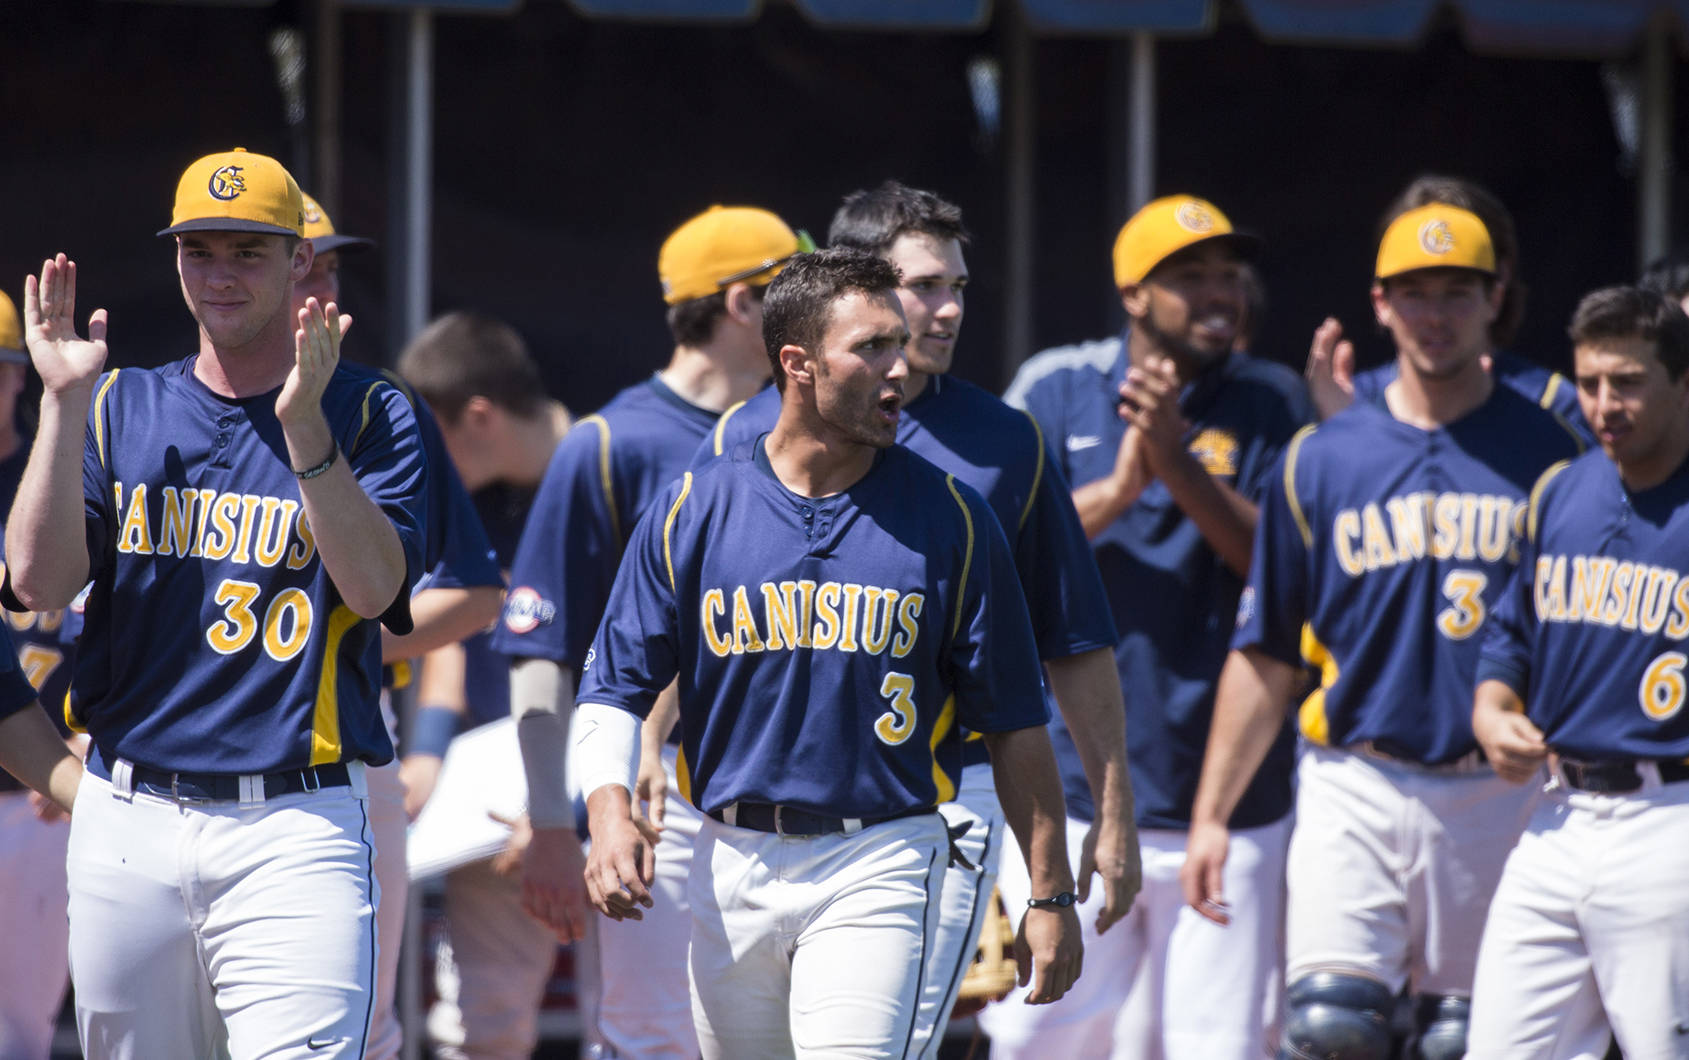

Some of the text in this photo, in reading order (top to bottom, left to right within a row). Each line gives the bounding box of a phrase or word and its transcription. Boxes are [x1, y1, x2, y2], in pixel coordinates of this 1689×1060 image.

[114, 481, 315, 570] ANISIUS
[206, 579, 313, 662] 30
[702, 580, 925, 657] CANISIUS
[1436, 568, 1488, 640] 3
[874, 672, 917, 746] 3
[1638, 651, 1688, 722] 6
